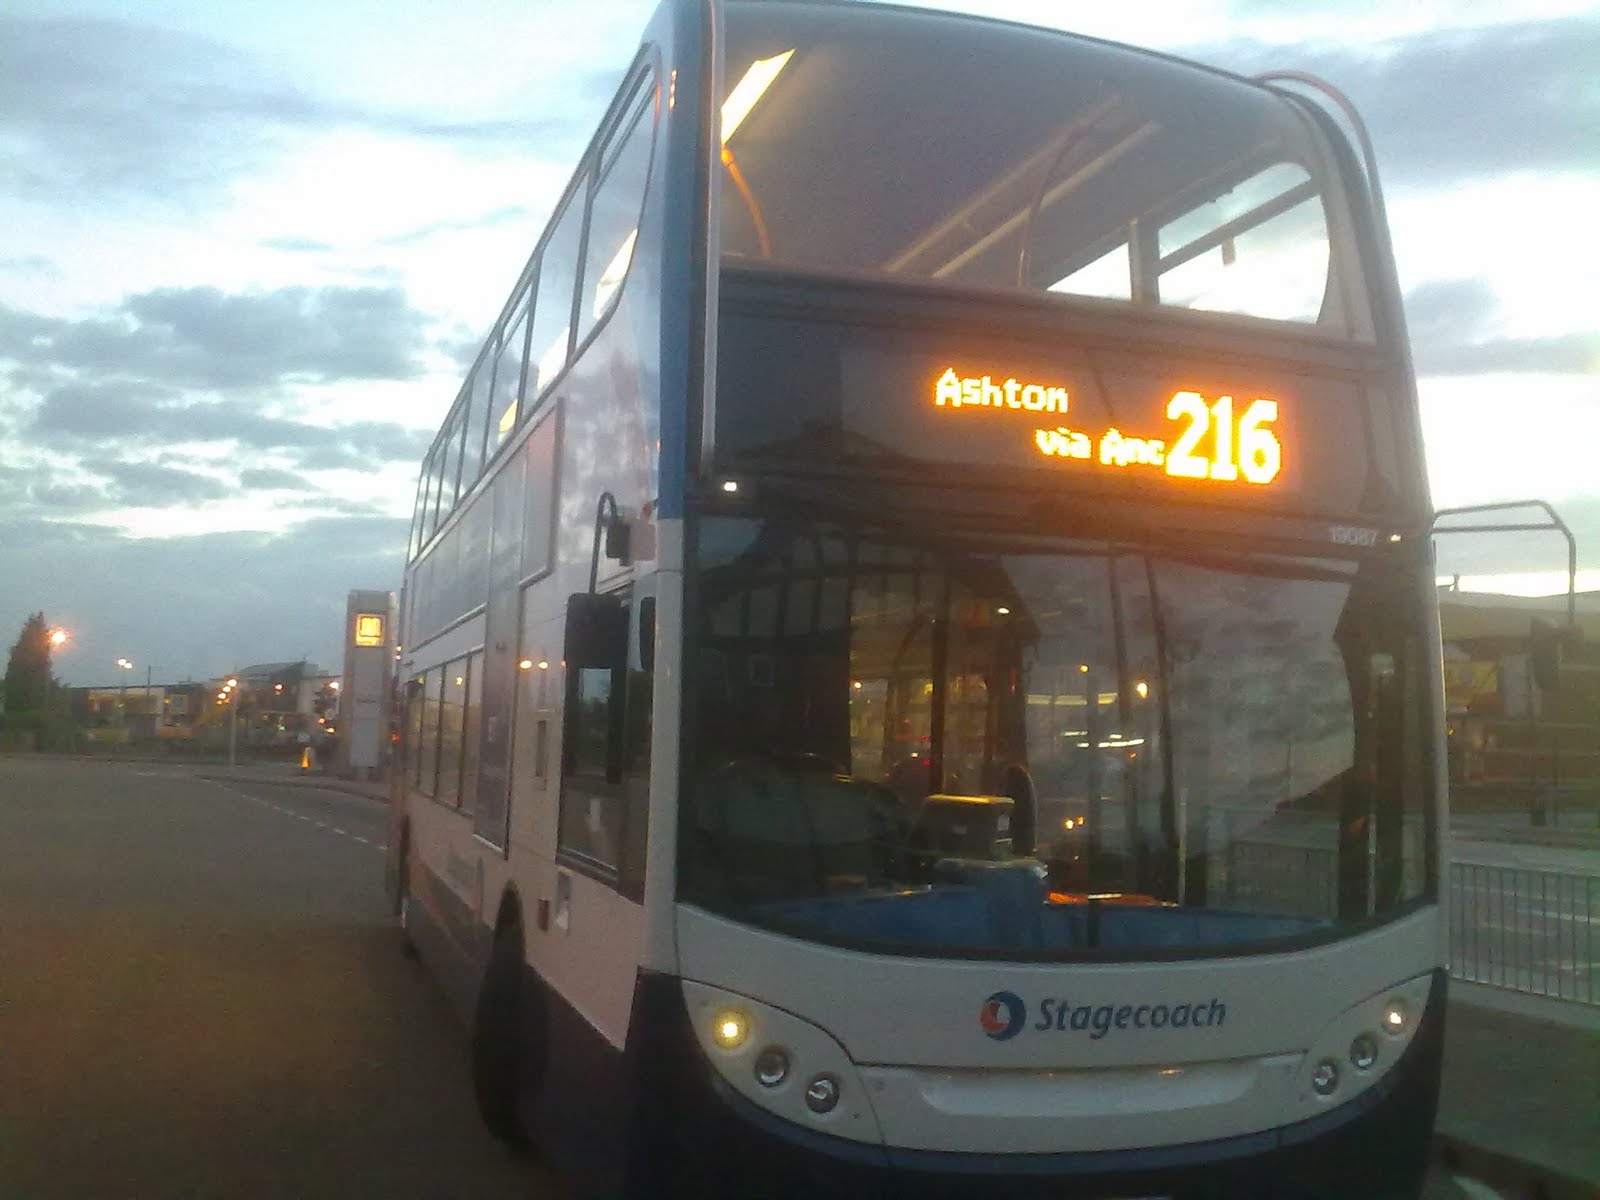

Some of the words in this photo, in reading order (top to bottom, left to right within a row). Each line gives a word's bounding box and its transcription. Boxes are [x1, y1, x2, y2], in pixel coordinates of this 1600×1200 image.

[935, 368, 1069, 412] Ashton
[1035, 426, 1092, 459] via
[1099, 427, 1165, 466] Anc
[1166, 391, 1281, 484] 216
[1035, 998, 1227, 1040] Stagecoach
